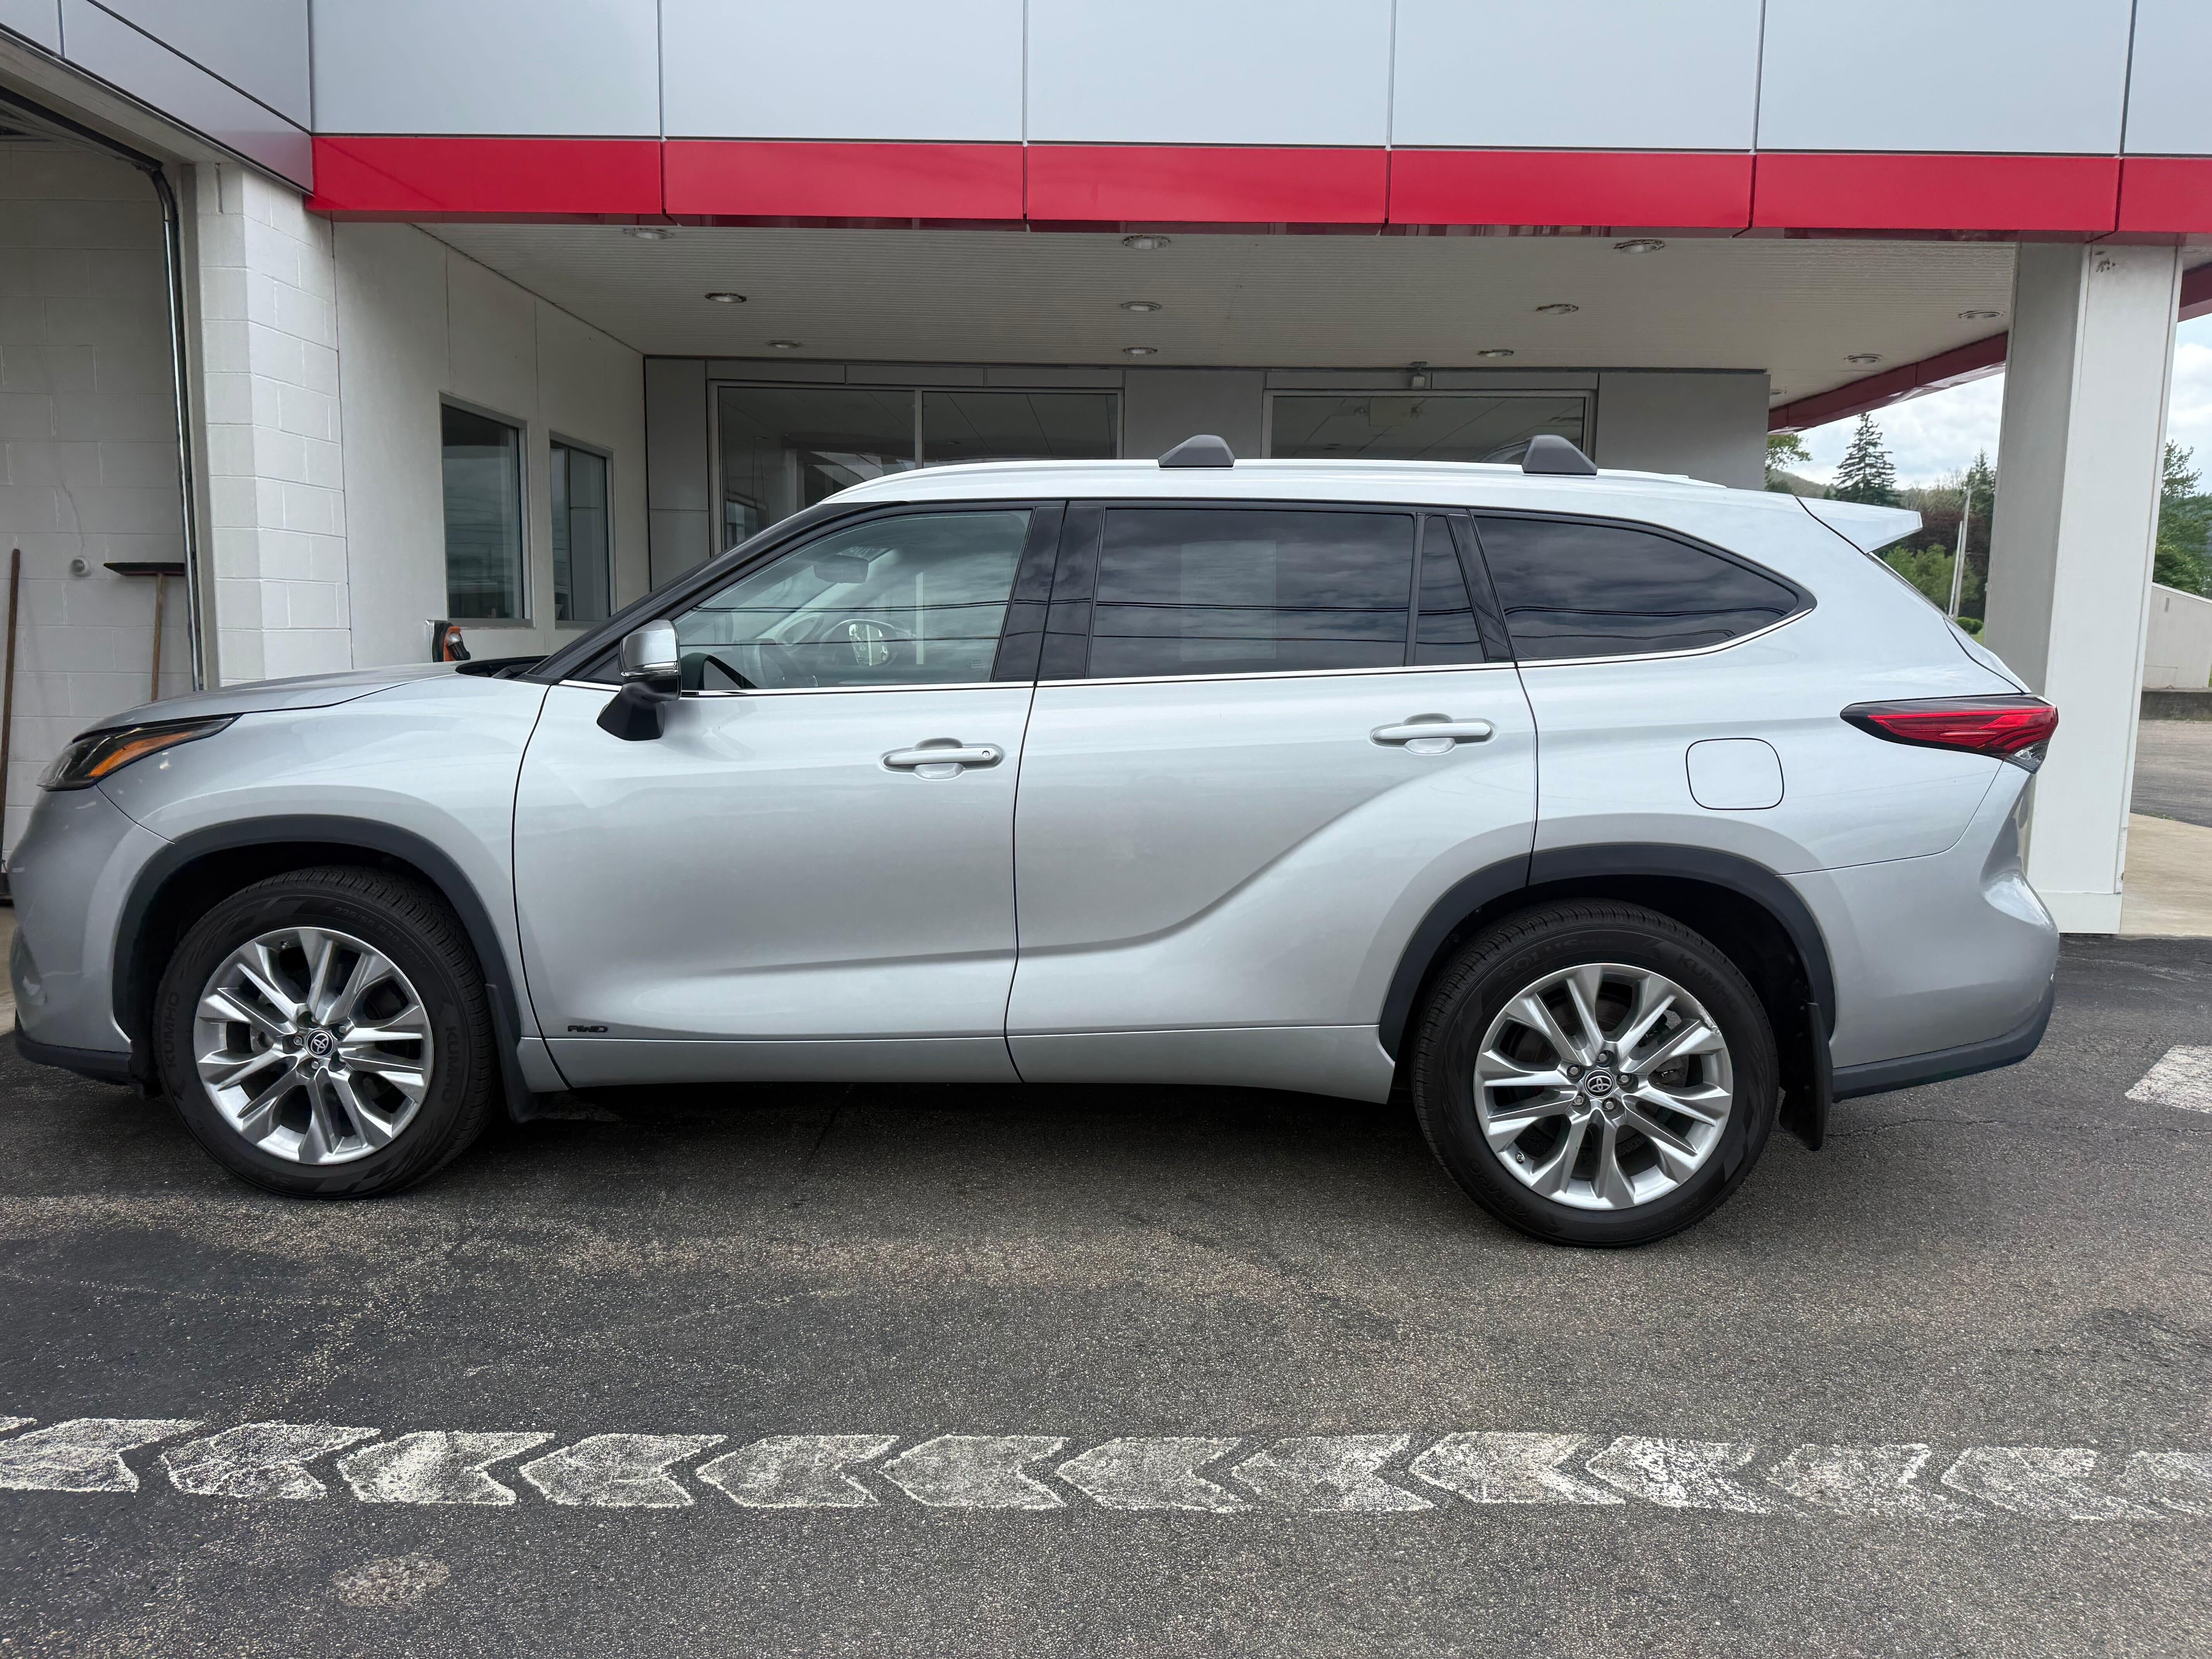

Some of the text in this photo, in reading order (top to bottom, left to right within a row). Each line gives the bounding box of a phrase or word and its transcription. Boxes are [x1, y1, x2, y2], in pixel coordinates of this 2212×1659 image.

[333, 907, 376, 926] 235/55
[376, 924, 400, 942] R20
[1501, 939, 1579, 981] SOLUS
[1677, 953, 1739, 1015] KUMHO
[164, 991, 180, 1068] KUMHO
[441, 1026, 459, 1103] KUMHO
[1468, 1162, 1530, 1219] KUMHO
